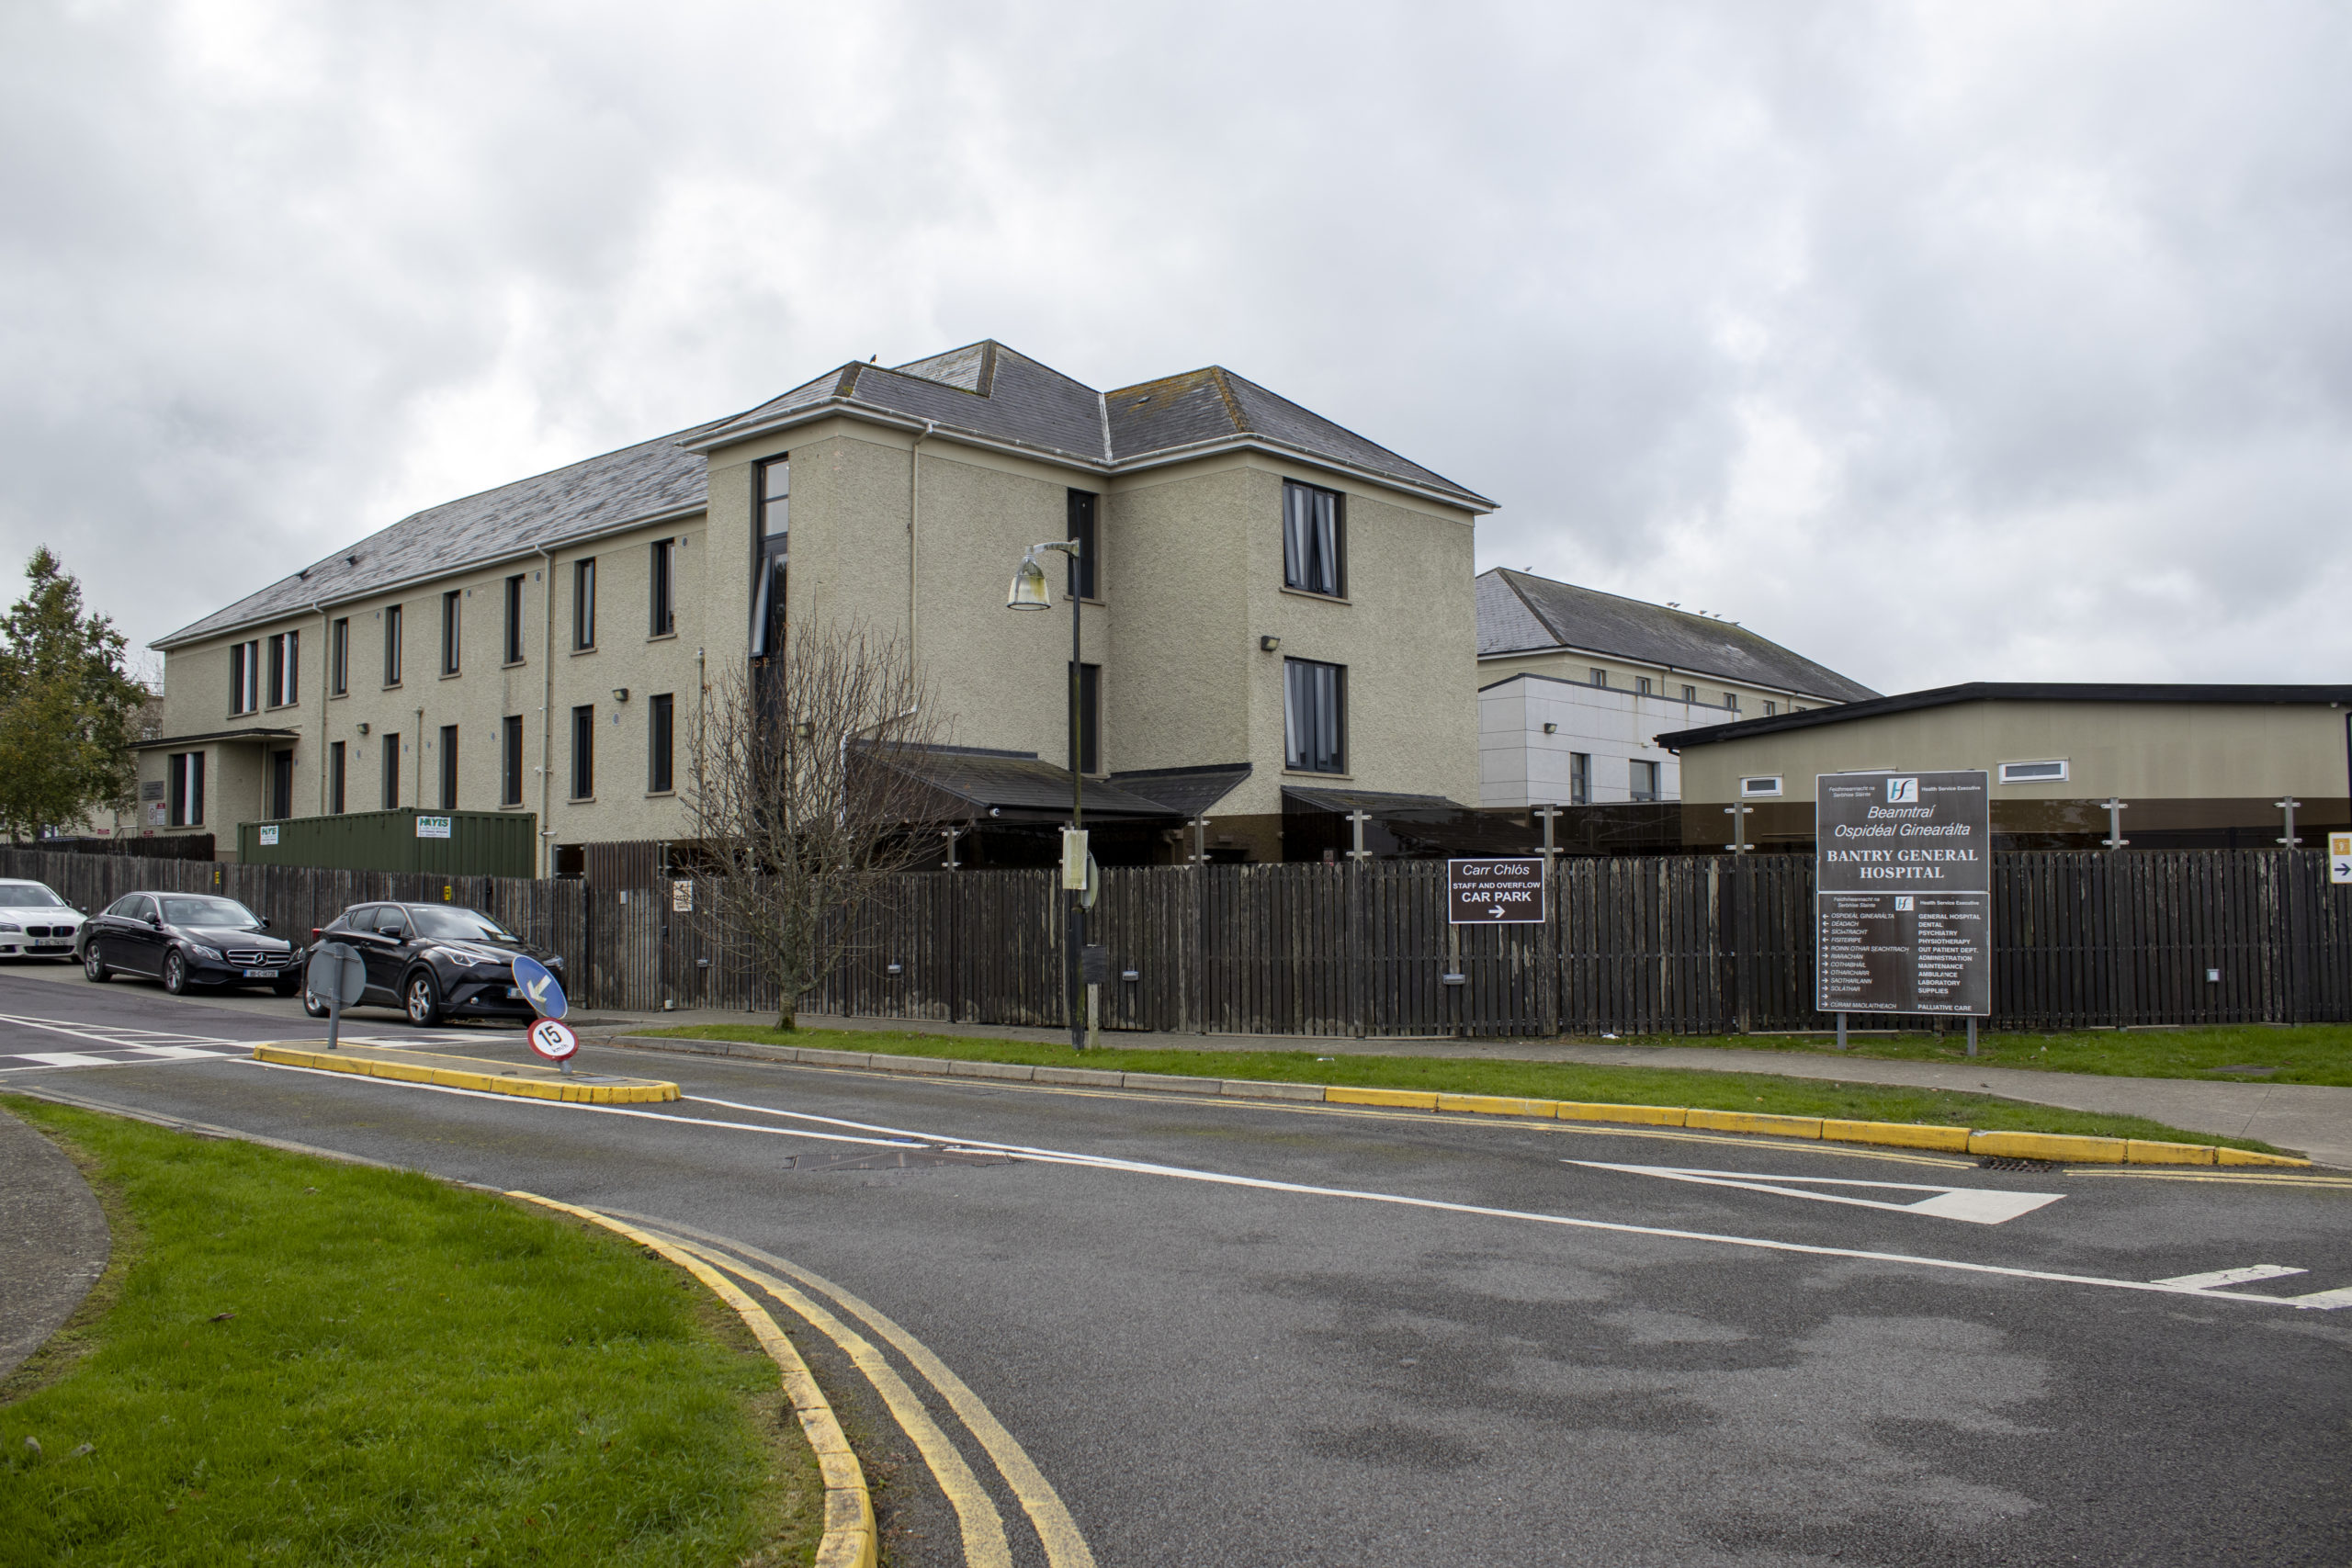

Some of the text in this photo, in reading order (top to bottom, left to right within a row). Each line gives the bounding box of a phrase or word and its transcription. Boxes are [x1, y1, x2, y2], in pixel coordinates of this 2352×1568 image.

[1867, 805, 1937, 819] Beanntraí
[1834, 823, 1971, 840] Ospidéal Ginearálta
[1826, 849, 1979, 863] BANTRY GENERAL
[1463, 863, 1531, 875] Carr Chlós
[1860, 867, 1944, 879] HOSPITAL
[1461, 891, 1532, 902] CAR PARK
[538, 1025, 562, 1046] 15
[551, 1043, 570, 1053] km/h
